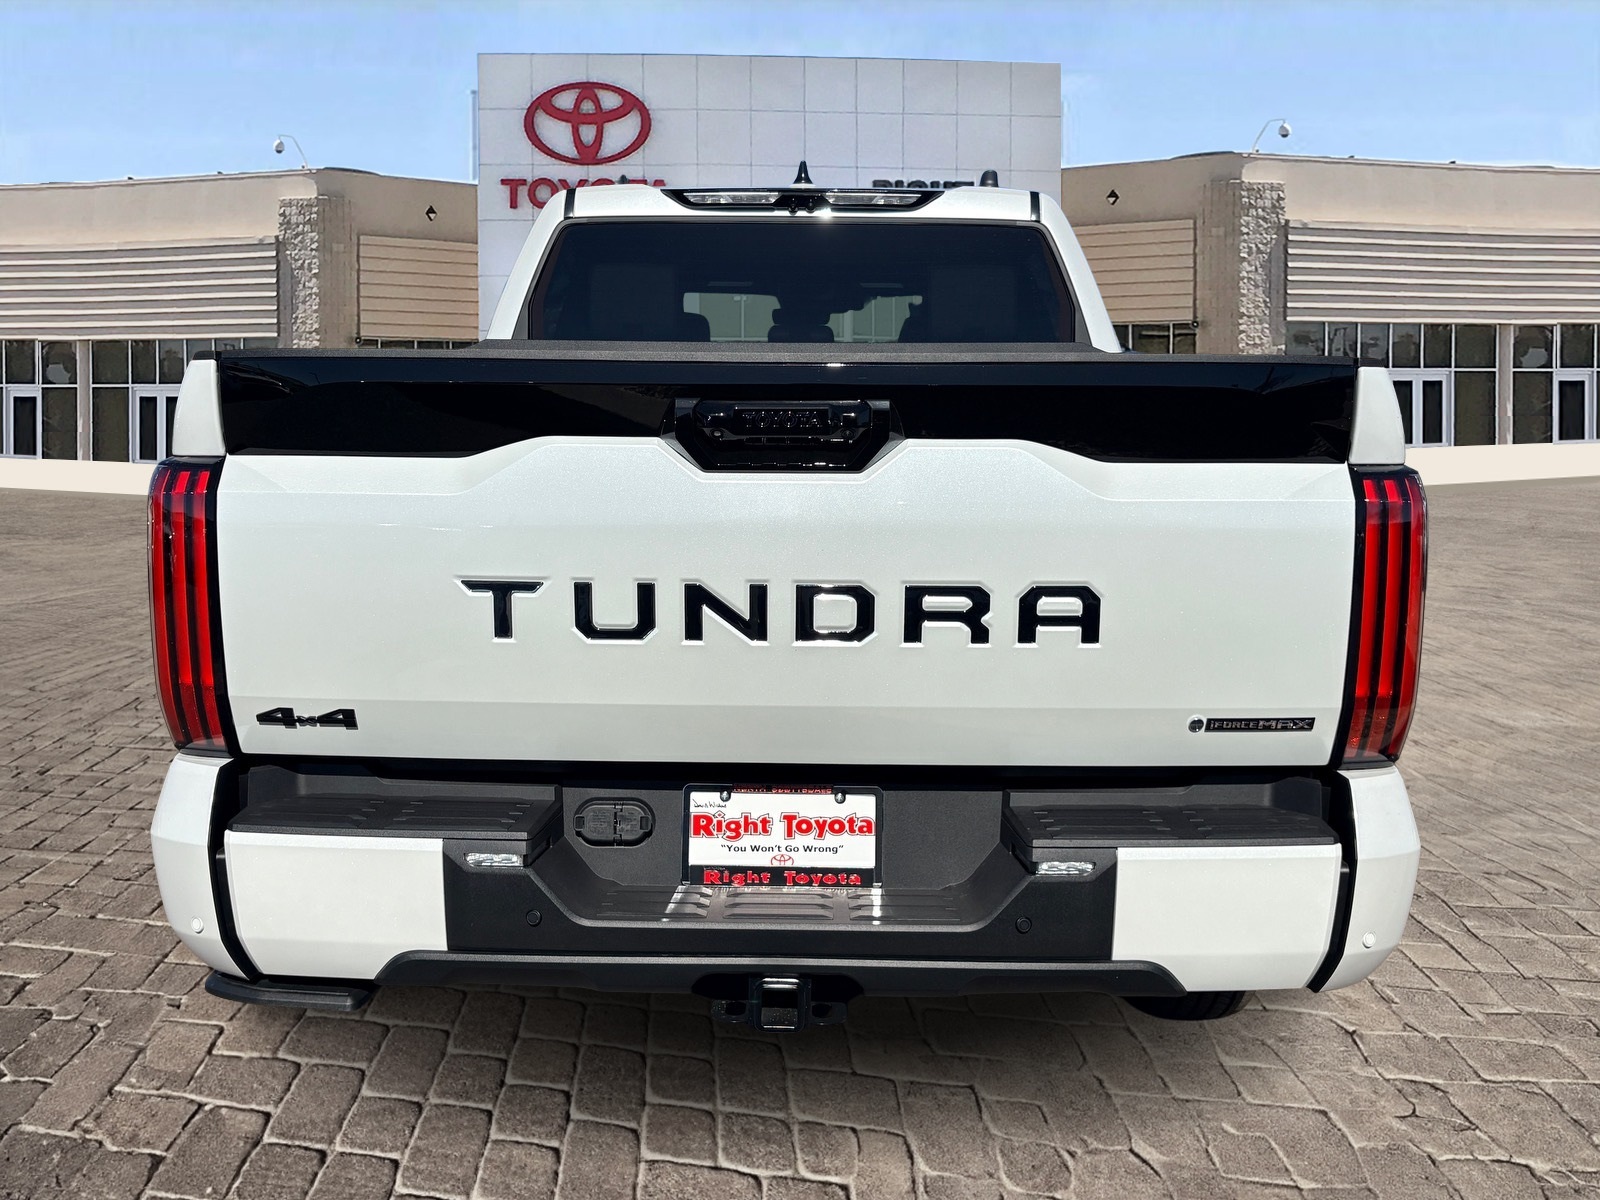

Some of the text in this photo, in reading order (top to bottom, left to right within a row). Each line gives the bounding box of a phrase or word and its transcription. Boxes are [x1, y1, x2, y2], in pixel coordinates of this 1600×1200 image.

[742, 410, 824, 429] TOYOTA
[459, 578, 1102, 646] TUNDRA
[690, 811, 875, 842] Right Toyota
[784, 844, 799, 853] Go
[703, 870, 861, 886] Right Toyota
